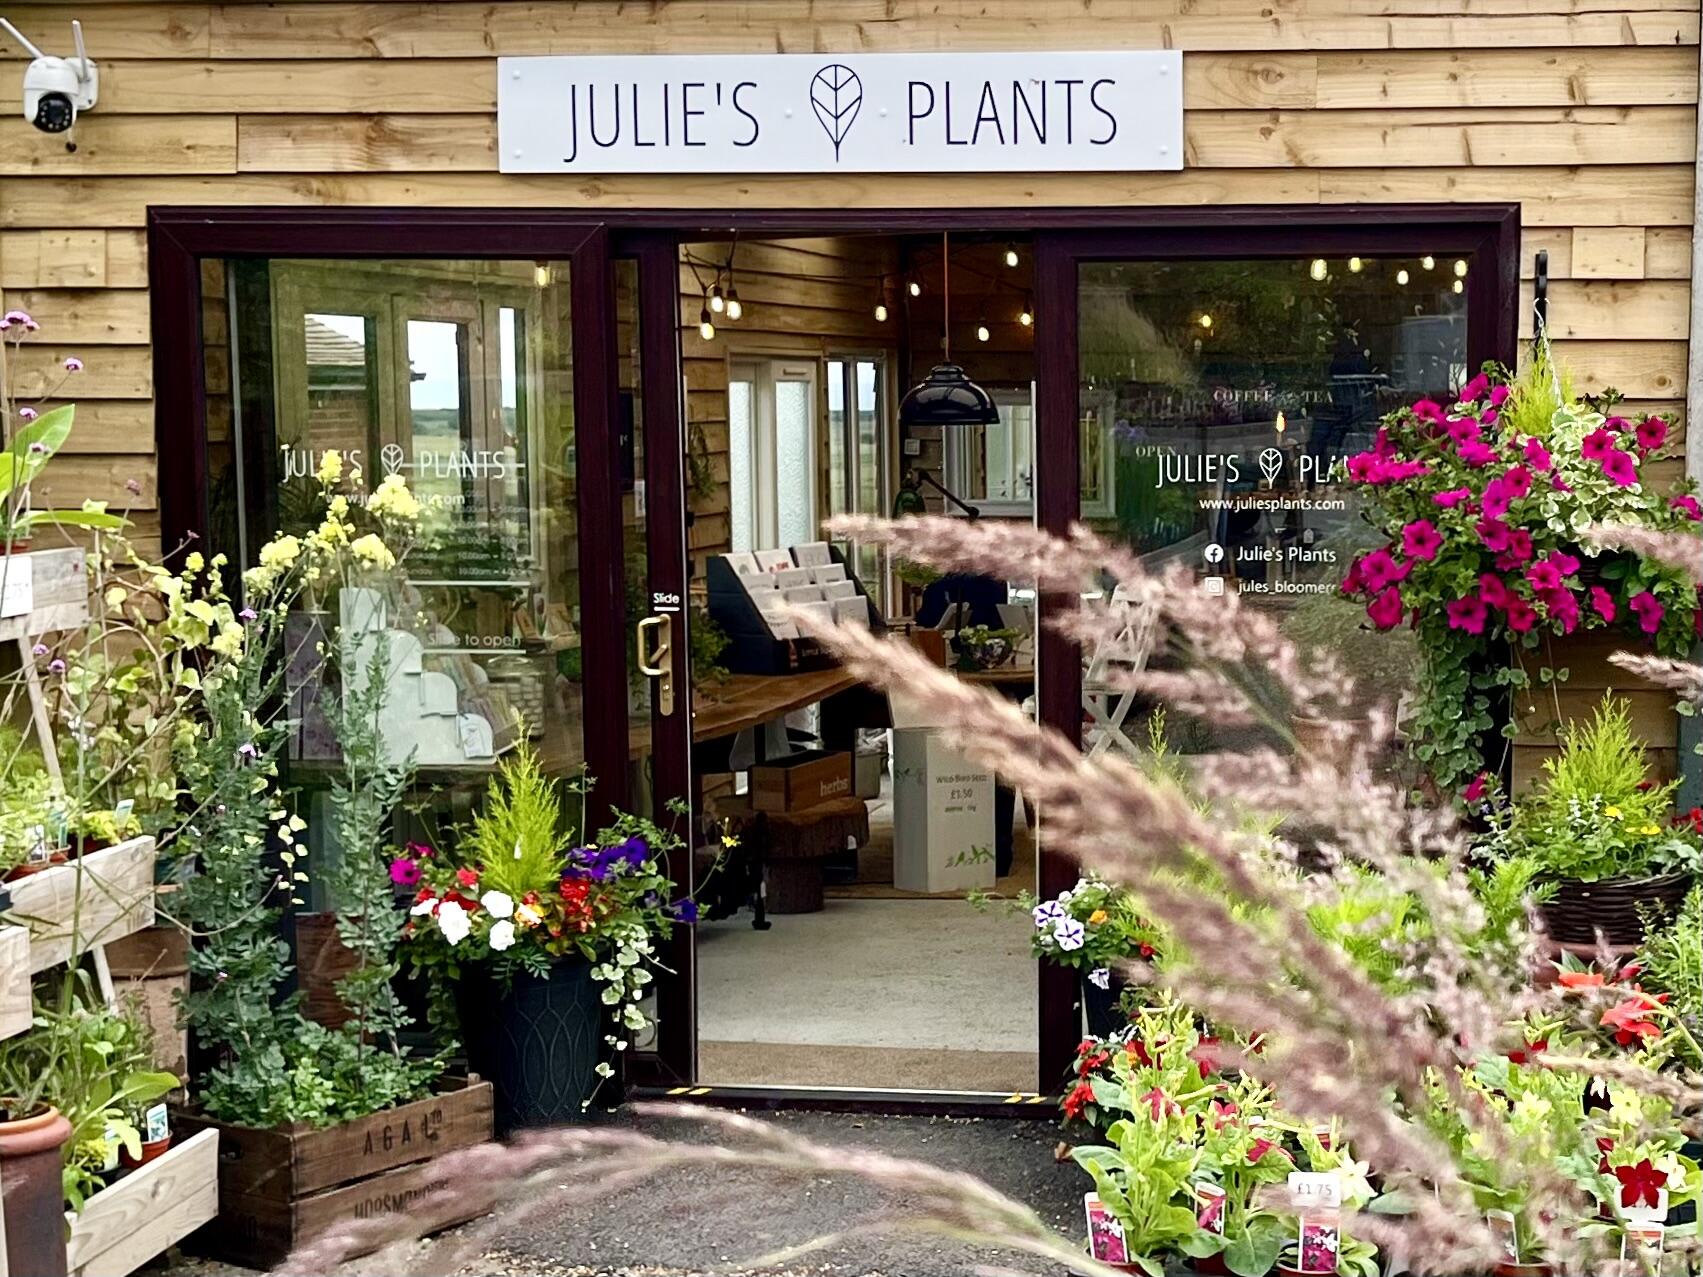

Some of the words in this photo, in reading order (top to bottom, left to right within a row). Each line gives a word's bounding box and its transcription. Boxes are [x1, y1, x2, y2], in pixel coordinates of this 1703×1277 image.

[563, 81, 760, 163] JULIE'S
[908, 79, 1118, 147] PLANTS
[1213, 389, 1274, 402] COFFEE
[1303, 390, 1333, 403] TEA
[281, 449, 363, 483] JUL'S
[420, 450, 506, 479] PLANTS
[1156, 454, 1240, 489] JULIE'S
[1299, 454, 1353, 483] PLA
[1199, 498, 1345, 513] www.juliesplants.com
[1236, 545, 1284, 562] Julie's
[1288, 546, 1337, 563] Plants
[653, 592, 680, 604] Slide
[465, 633, 480, 646] to
[482, 635, 522, 649] open
